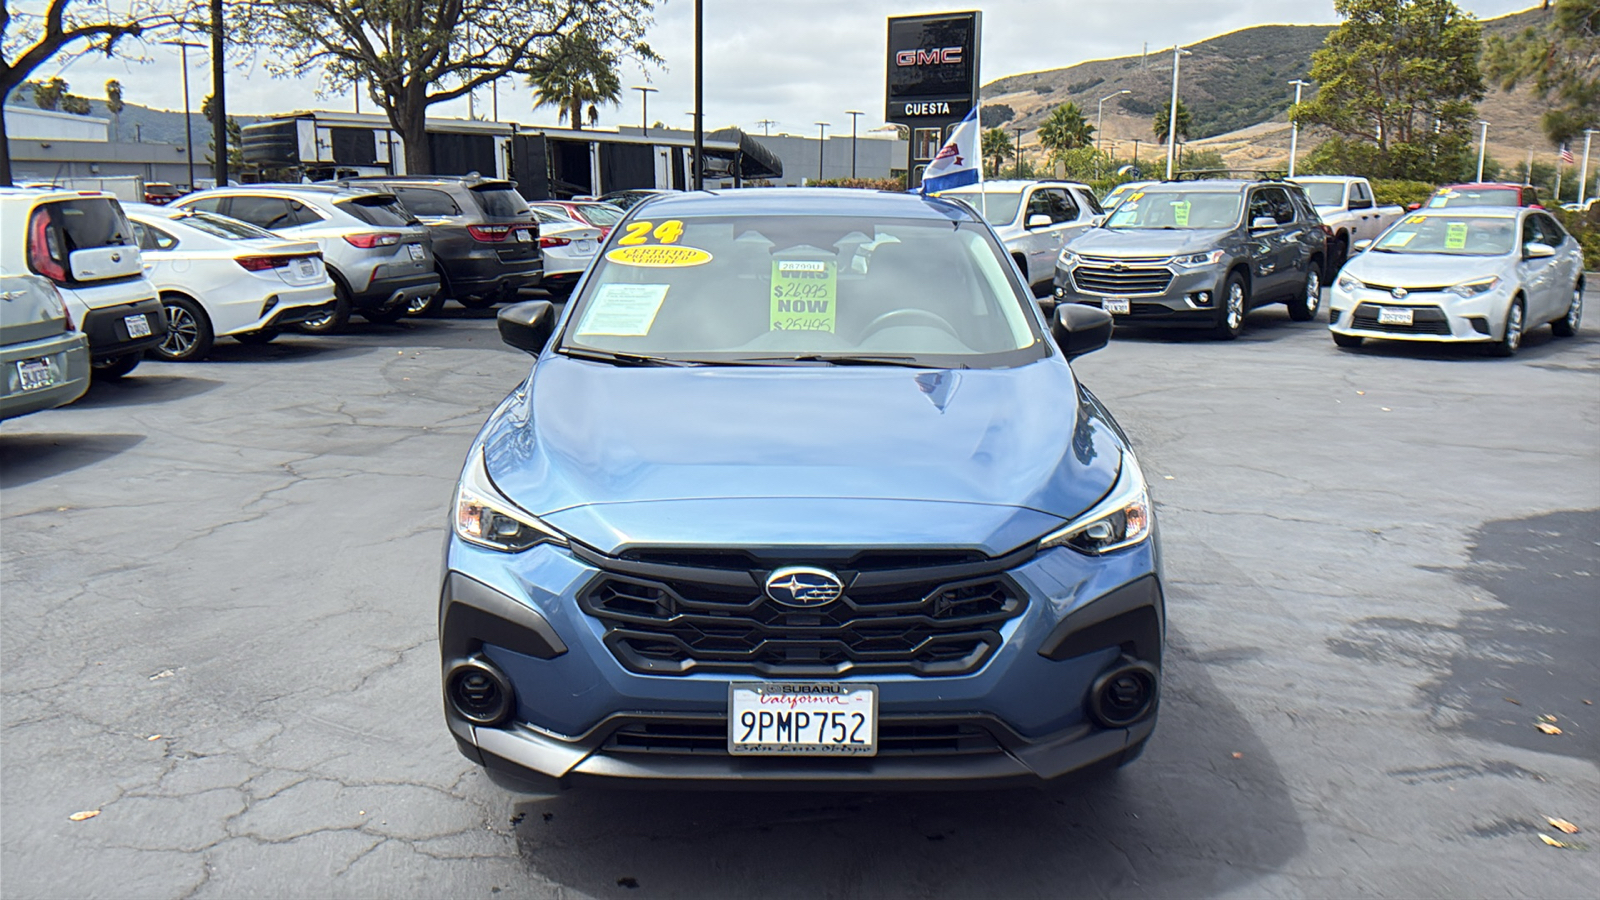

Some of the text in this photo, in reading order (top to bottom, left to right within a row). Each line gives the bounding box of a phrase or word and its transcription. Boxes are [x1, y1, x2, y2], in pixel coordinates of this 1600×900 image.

[896, 46, 963, 66] GMC
[905, 102, 950, 116] CUESTA
[618, 220, 684, 245] 24
[623, 249, 697, 257] CERTIFIED
[778, 300, 828, 313] NOW
[782, 685, 841, 694] SUBARU
[760, 694, 849, 709] California
[740, 711, 865, 743] 9PMP752
[777, 744, 816, 752] Luis
